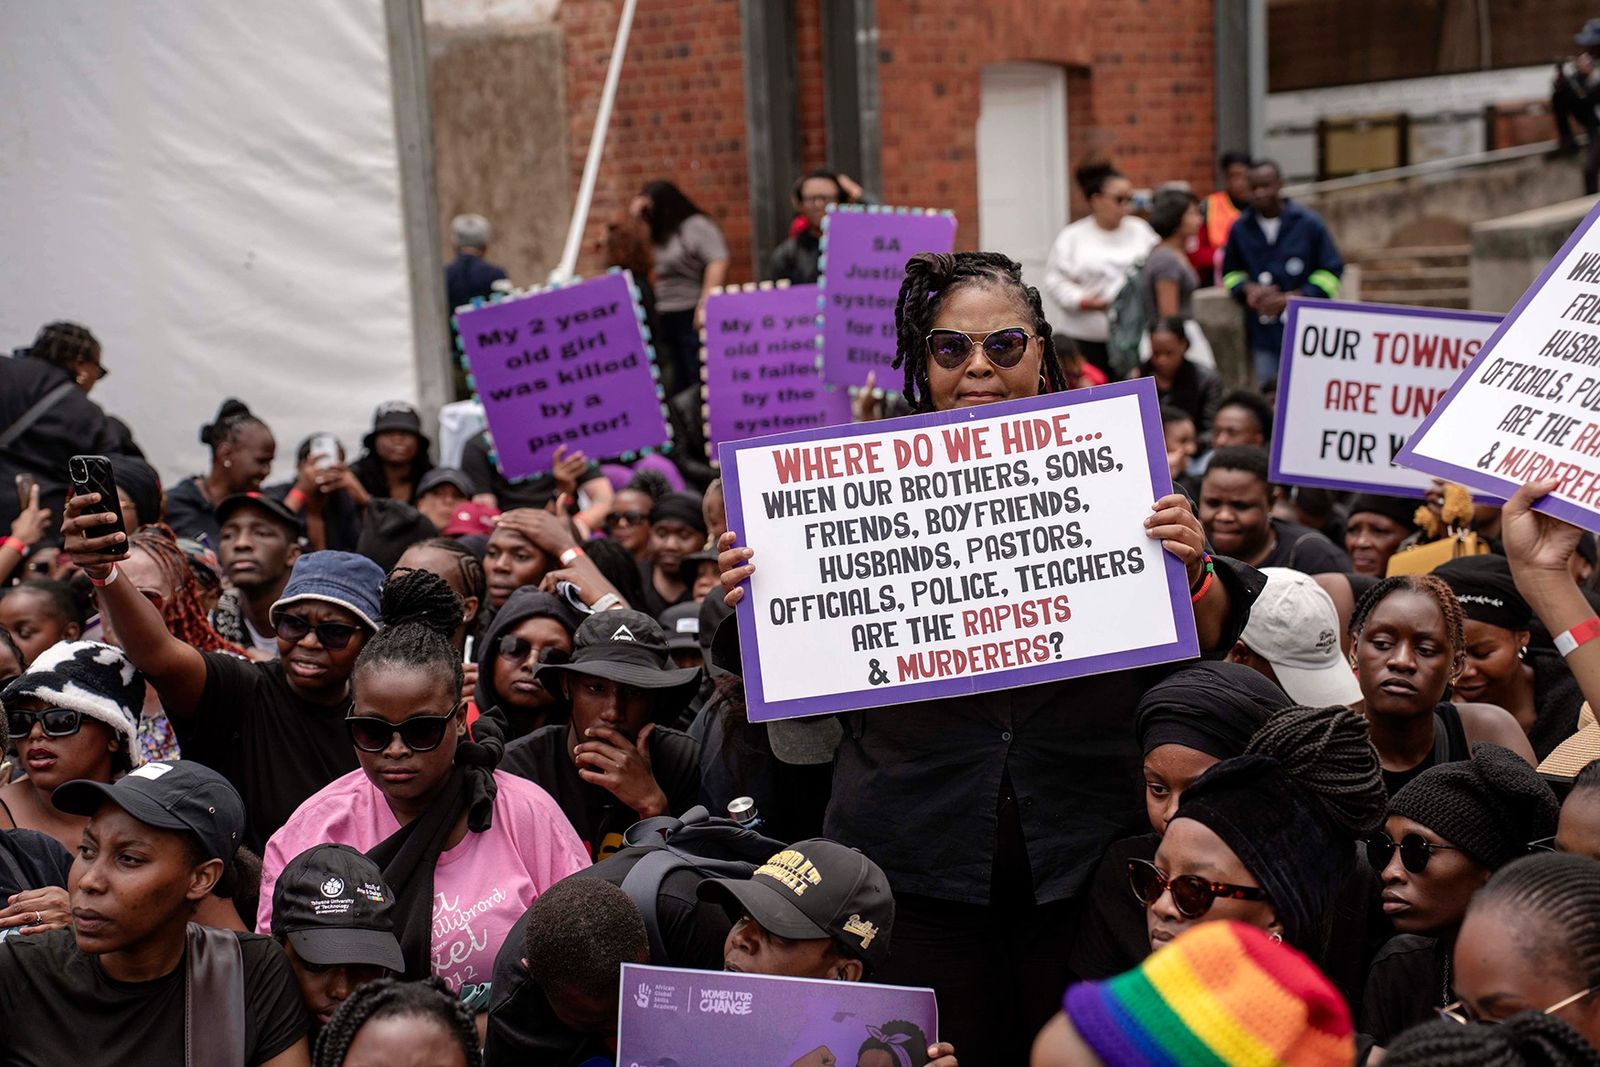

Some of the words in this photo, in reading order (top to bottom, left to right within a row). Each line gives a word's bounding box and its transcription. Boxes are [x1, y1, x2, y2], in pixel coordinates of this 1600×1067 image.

[477, 328, 518, 348] My
[529, 319, 544, 335] 2
[555, 301, 620, 331] year
[721, 318, 752, 335] My
[846, 318, 873, 337] for
[506, 346, 549, 370] old
[560, 331, 607, 361] girl
[724, 341, 758, 358] old
[1301, 325, 1361, 361] OUR
[1373, 331, 1482, 370] TOWNS
[489, 378, 548, 402] was
[557, 351, 638, 385] killed
[742, 389, 769, 408] by
[777, 387, 815, 403] the
[1325, 379, 1382, 414] ARE
[1480, 357, 1573, 404] OFFICIALS,
[541, 398, 573, 418] by
[585, 393, 603, 408] a
[734, 410, 827, 433] system!
[1497, 404, 1543, 437] ARE
[1533, 412, 1582, 447] THE
[528, 411, 630, 453] pastor!
[772, 441, 884, 485] WHERE
[893, 433, 933, 470] DO
[941, 426, 993, 464] WE
[1000, 413, 1103, 456] HIDE...
[1320, 430, 1376, 464] FOR
[1477, 441, 1501, 469] &
[762, 487, 837, 519] WHEN
[843, 478, 893, 510] OUR
[901, 459, 1039, 503] BROTHERS,
[1045, 445, 1123, 481] SONS,
[805, 511, 919, 550] FRIENDS,
[925, 486, 1091, 536] BOYFRIENDS,
[819, 542, 960, 584] HUSBANDS,
[966, 522, 1092, 564] PASTORS,
[769, 584, 905, 626] OFFICIALS,
[911, 571, 1008, 607] POLICE,
[1014, 546, 1145, 593] TEACHERS
[851, 620, 901, 652] ARE
[906, 613, 956, 644] THE
[962, 594, 1072, 638] RAPISTS
[867, 658, 890, 686] &
[896, 631, 1064, 683] MURDERERS?
[431, 887, 506, 941] illibrord
[653, 1003, 678, 1012] Academy
[699, 999, 753, 1015] CHANGE
[700, 988, 734, 1000] WOMEN
[735, 991, 753, 1001] FOR
